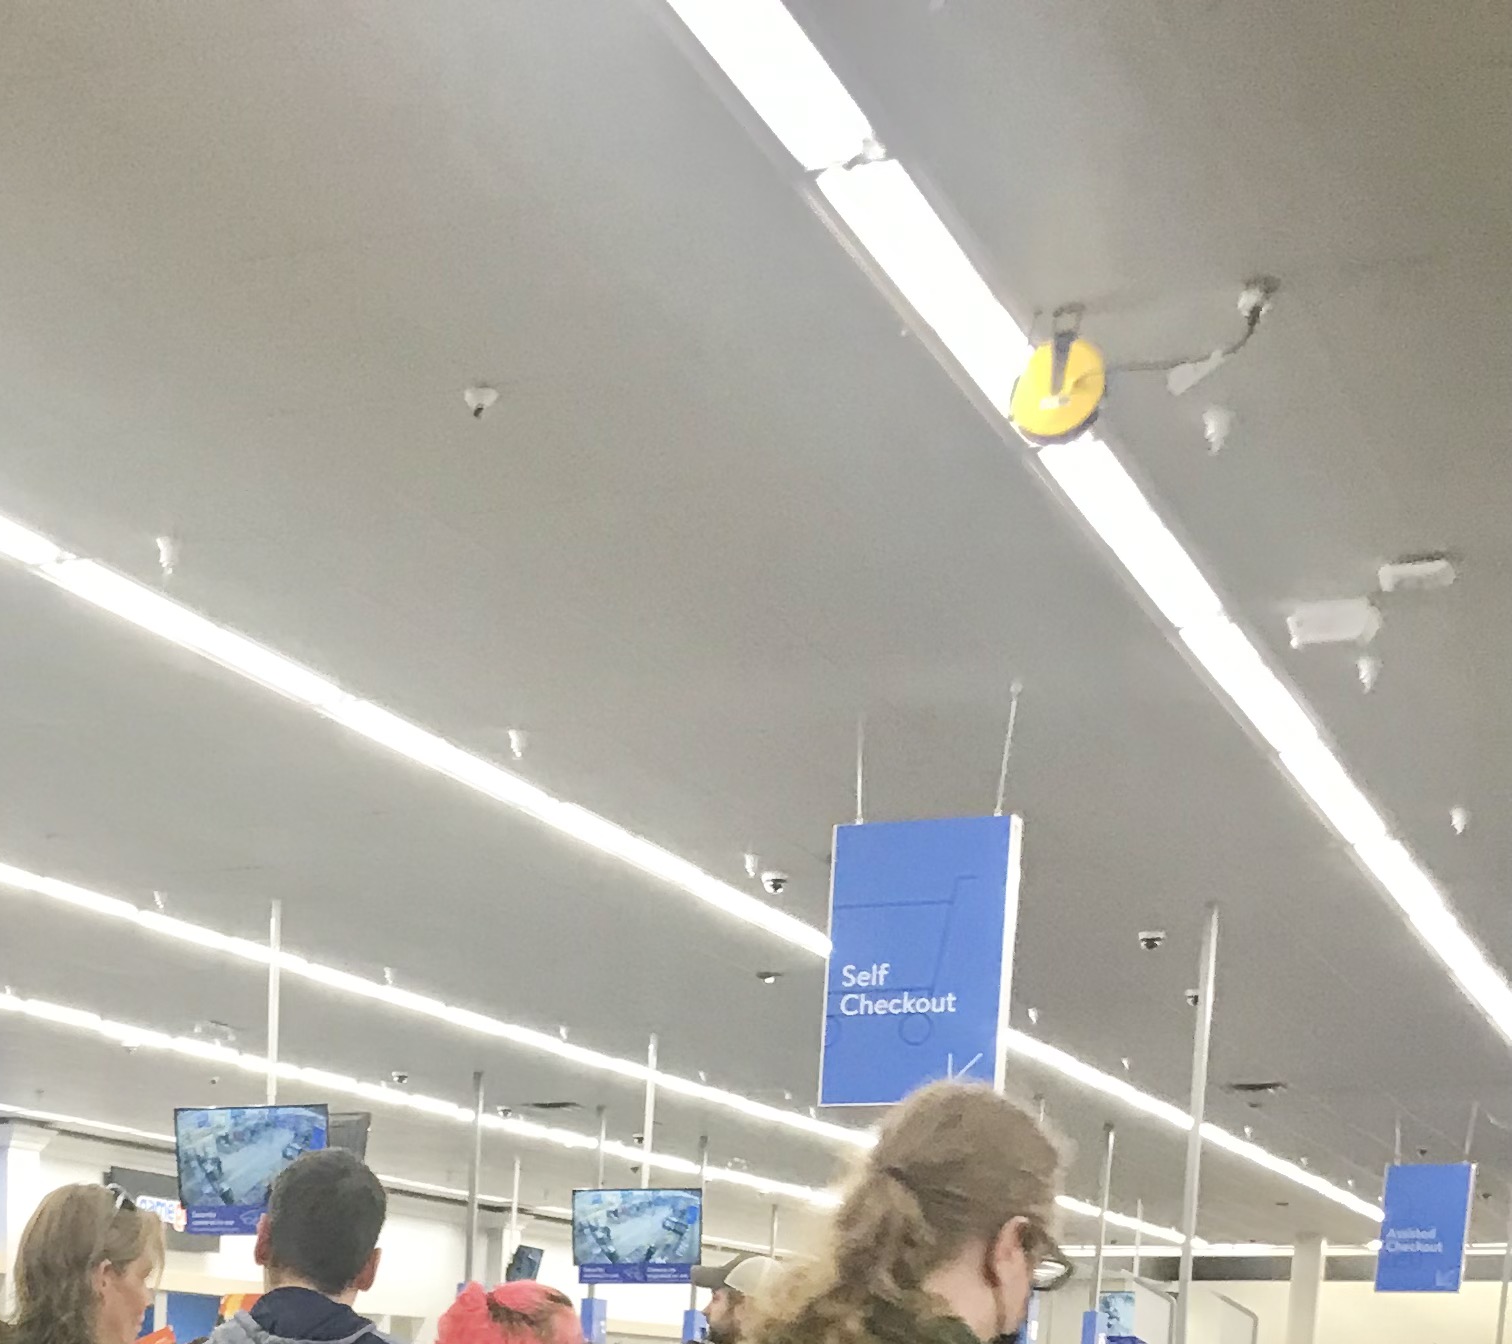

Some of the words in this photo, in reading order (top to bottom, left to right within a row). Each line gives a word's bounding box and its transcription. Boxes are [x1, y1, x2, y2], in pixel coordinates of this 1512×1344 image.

[841, 963, 890, 987] Self
[840, 991, 957, 1016] Checkout
[1385, 1240, 1443, 1253] Checkout
